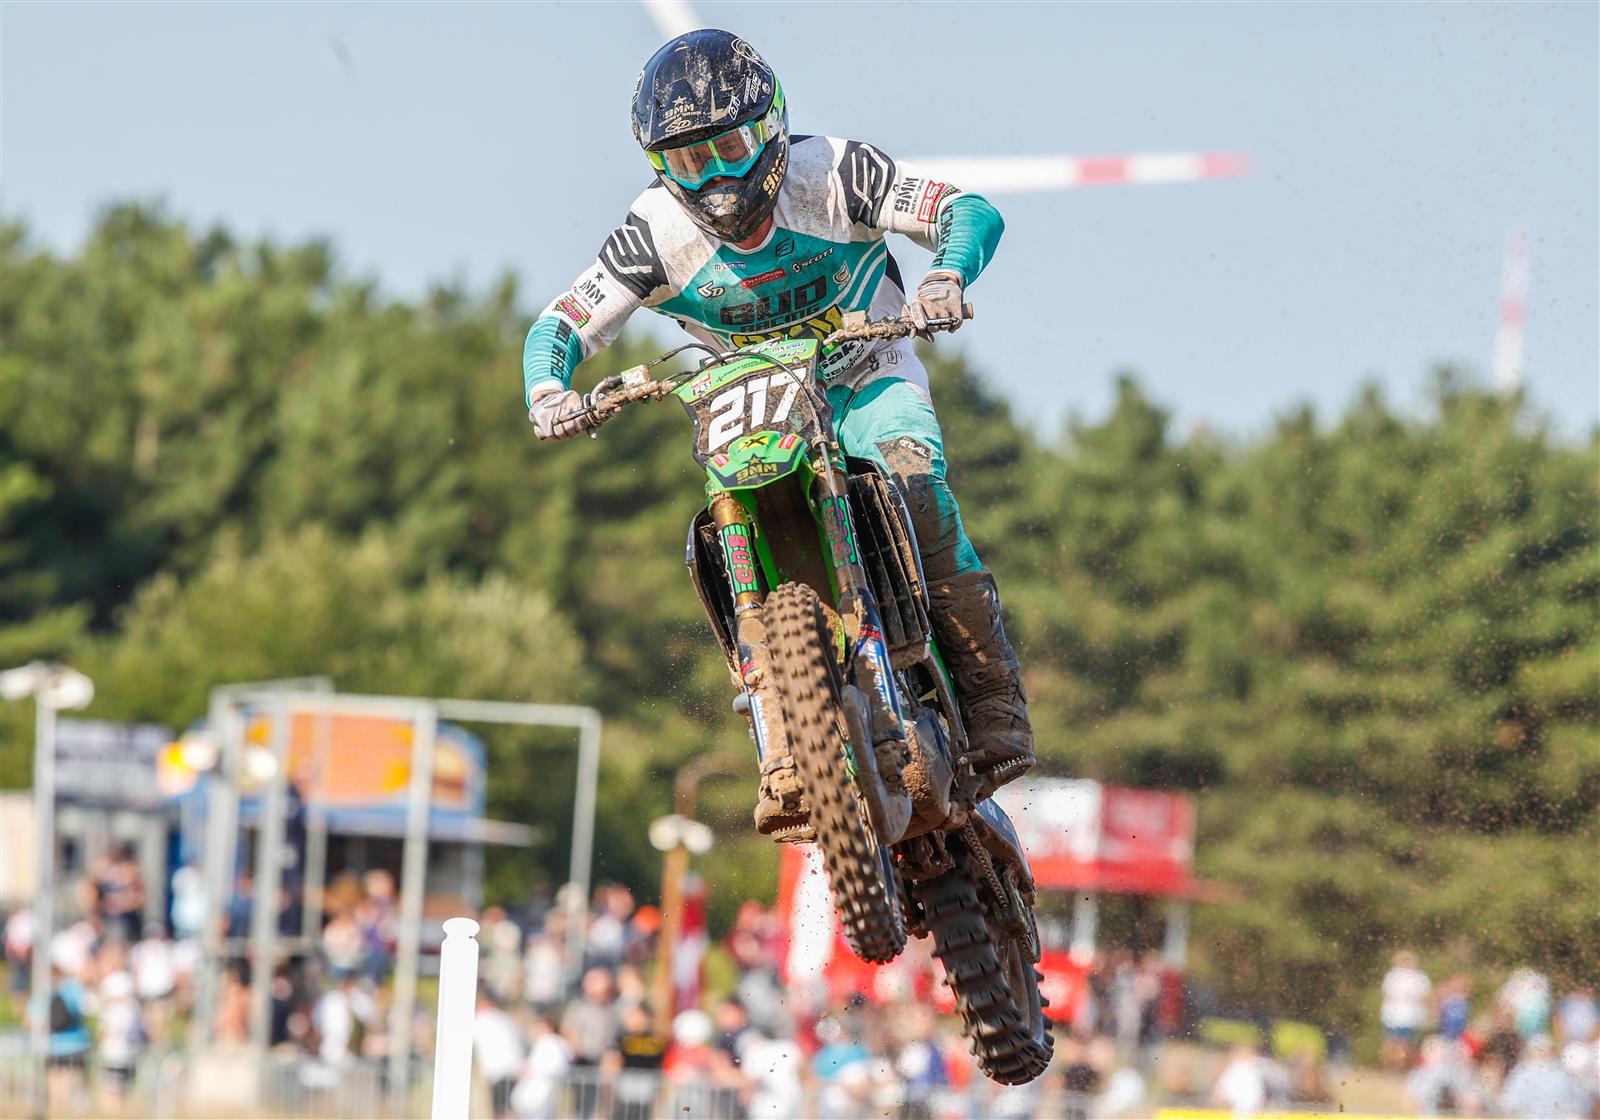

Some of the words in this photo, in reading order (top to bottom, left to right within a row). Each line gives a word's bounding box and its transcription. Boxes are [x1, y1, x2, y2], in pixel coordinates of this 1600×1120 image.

[664, 103, 694, 118] 9MM
[895, 177, 919, 212] 9MM
[801, 247, 834, 268] SCOTT
[742, 270, 784, 286] CHAMPION
[720, 275, 827, 326] BUD
[740, 303, 822, 332] RACING
[708, 367, 807, 453] 217
[736, 463, 778, 479] 9MM
[727, 534, 755, 584] BUD
